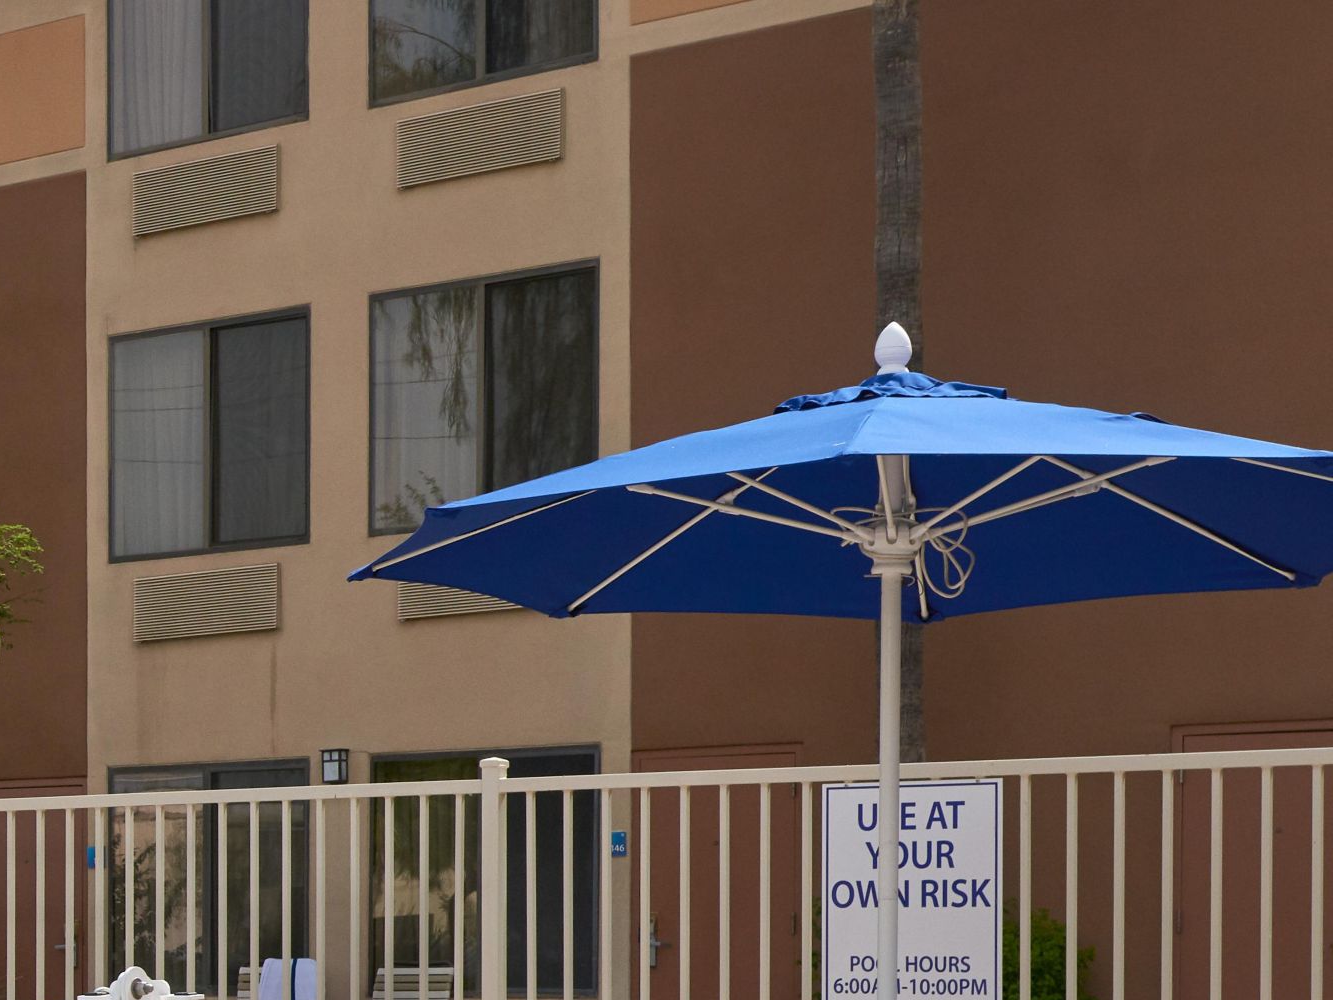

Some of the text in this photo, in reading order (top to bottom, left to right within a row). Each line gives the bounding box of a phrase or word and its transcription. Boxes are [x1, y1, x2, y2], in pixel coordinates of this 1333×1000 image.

[857, 800, 966, 832] UE AT
[921, 878, 991, 909] RISK
[849, 955, 971, 973] PO HOURS
[832, 978, 988, 996] 6:00-10:00PM
